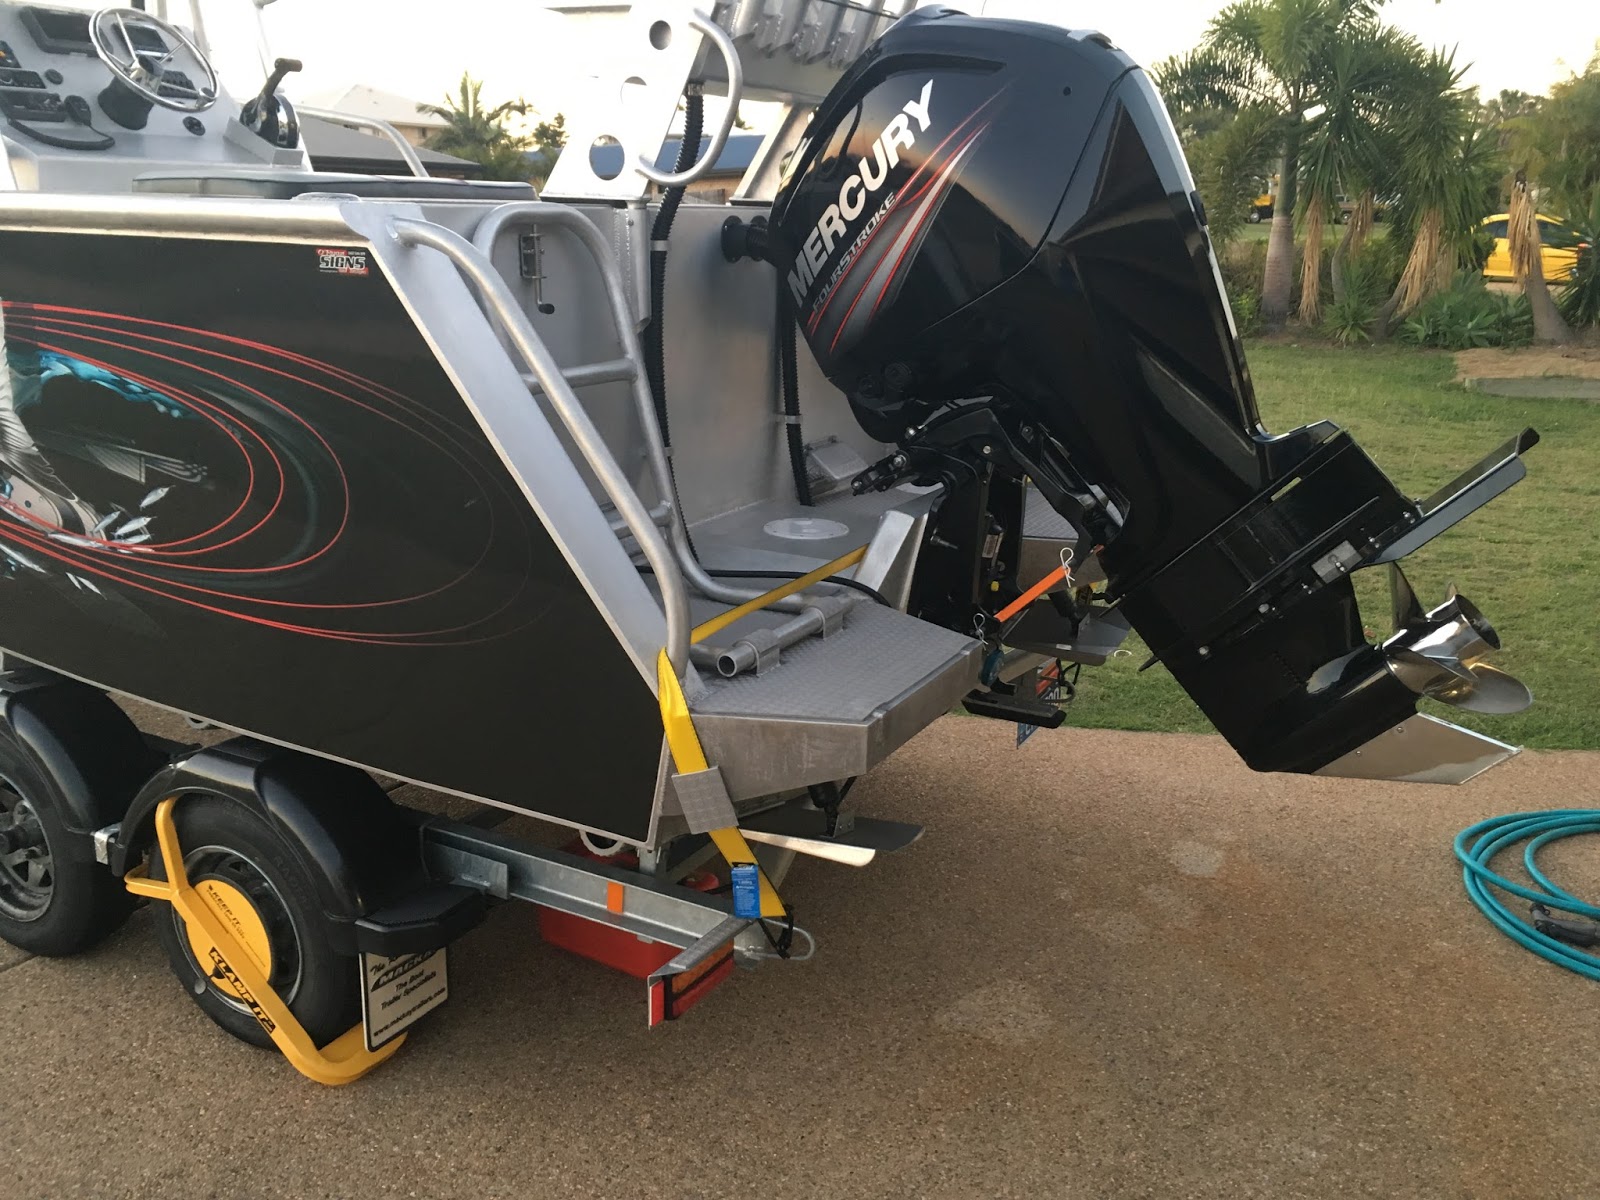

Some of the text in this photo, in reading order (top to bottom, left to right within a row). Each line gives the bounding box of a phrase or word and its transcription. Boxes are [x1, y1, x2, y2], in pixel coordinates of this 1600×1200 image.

[787, 79, 933, 307] MERCURY
[319, 255, 366, 270] SIGNS
[812, 192, 897, 313] FOURSTROKE
[213, 892, 233, 916] KEEP
[209, 950, 254, 1001] KLAMP
[252, 1006, 269, 1020] IT
